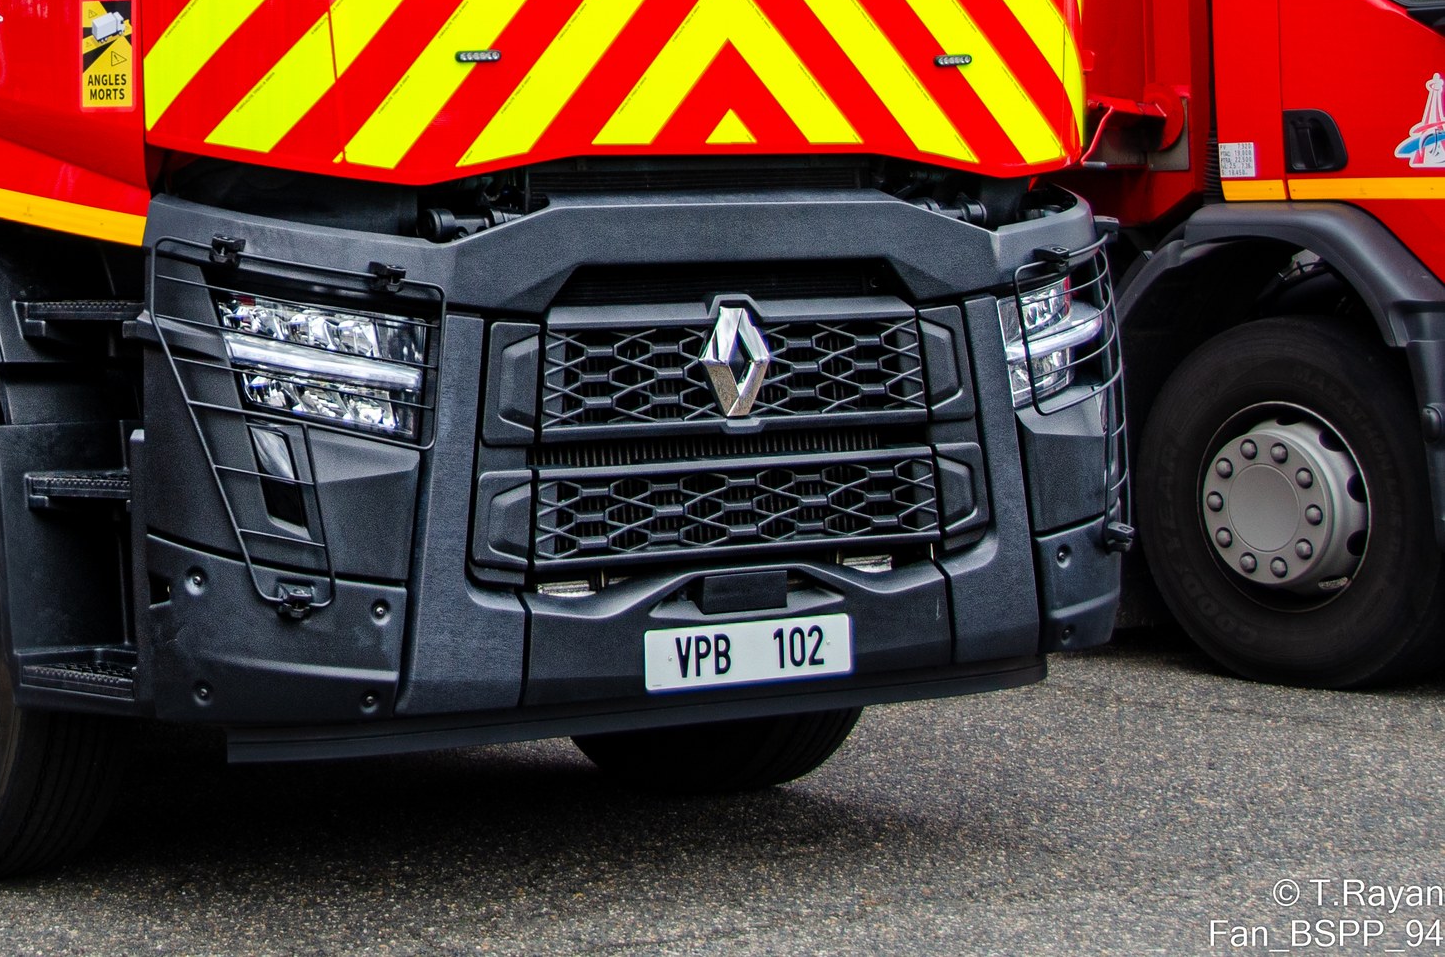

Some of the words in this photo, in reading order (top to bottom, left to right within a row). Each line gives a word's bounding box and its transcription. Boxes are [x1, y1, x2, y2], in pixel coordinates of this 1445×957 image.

[87, 74, 127, 86] ANGLES
[89, 88, 125, 101] MORTS
[675, 633, 731, 678] VPB
[773, 625, 825, 669] 102
